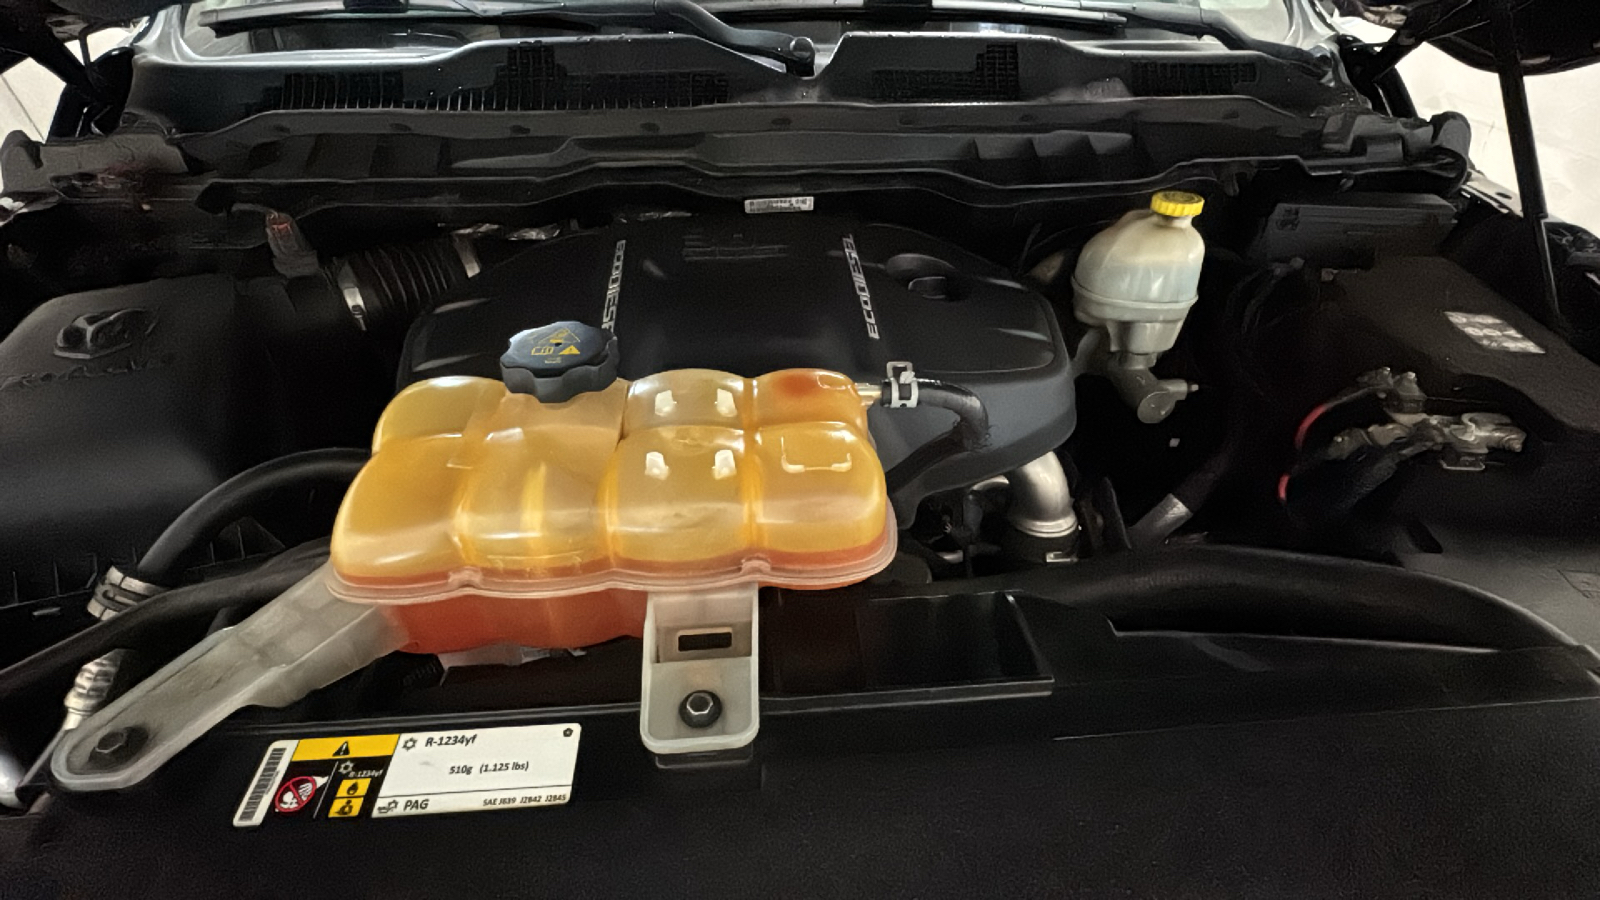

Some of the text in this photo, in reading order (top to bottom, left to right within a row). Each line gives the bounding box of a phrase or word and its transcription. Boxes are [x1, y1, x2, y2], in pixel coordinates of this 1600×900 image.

[601, 240, 626, 333] ECODIESE
[842, 233, 880, 339] ECODIESEL
[424, 733, 477, 748] R-1234yf
[449, 761, 529, 775] 510g (1.125 lbs)
[403, 798, 430, 811] PAG
[483, 797, 498, 806] SAE
[520, 795, 542, 804] J2842
[545, 793, 566, 802] J2845
